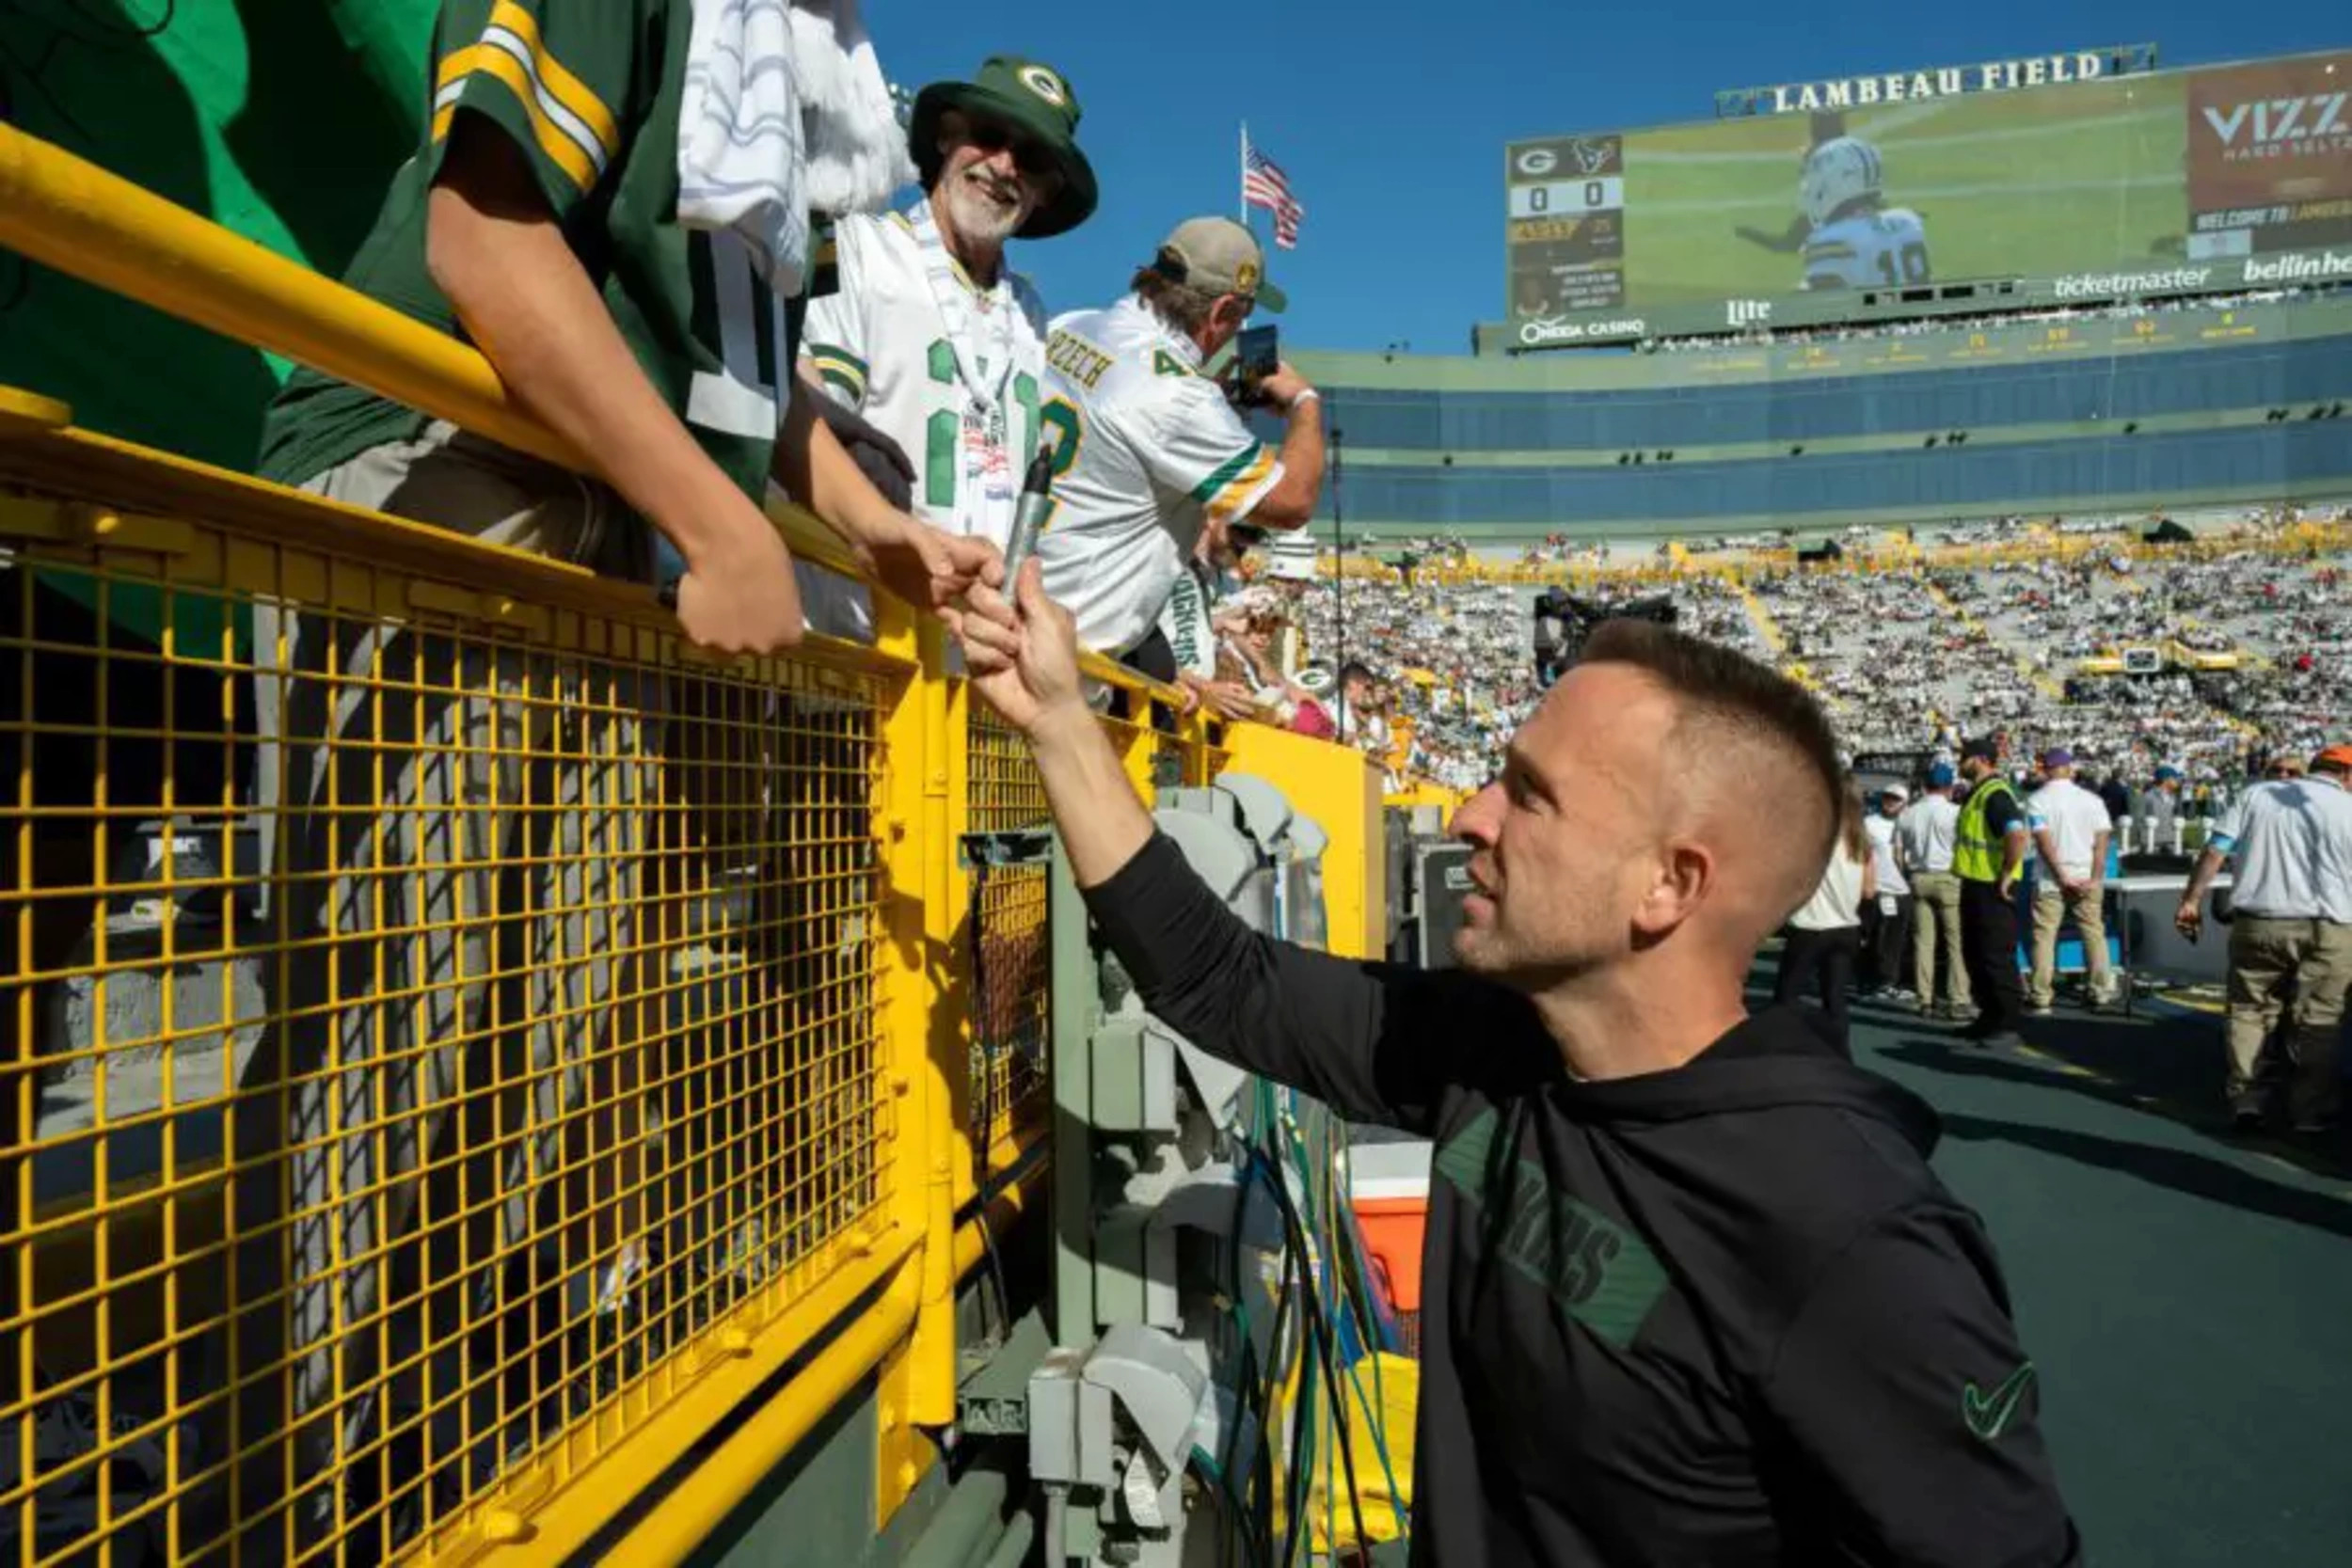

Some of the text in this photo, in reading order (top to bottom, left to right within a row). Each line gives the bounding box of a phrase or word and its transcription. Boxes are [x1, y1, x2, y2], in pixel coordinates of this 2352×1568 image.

[1774, 53, 2102, 113] LAMBEAU FIELD
[1530, 182, 1603, 213] 0 0
[2197, 205, 2264, 231] WELCOME
[2054, 266, 2211, 297] ticketmaster
[1726, 299, 1772, 326] Lite
[1588, 318, 1645, 337] CASINO
